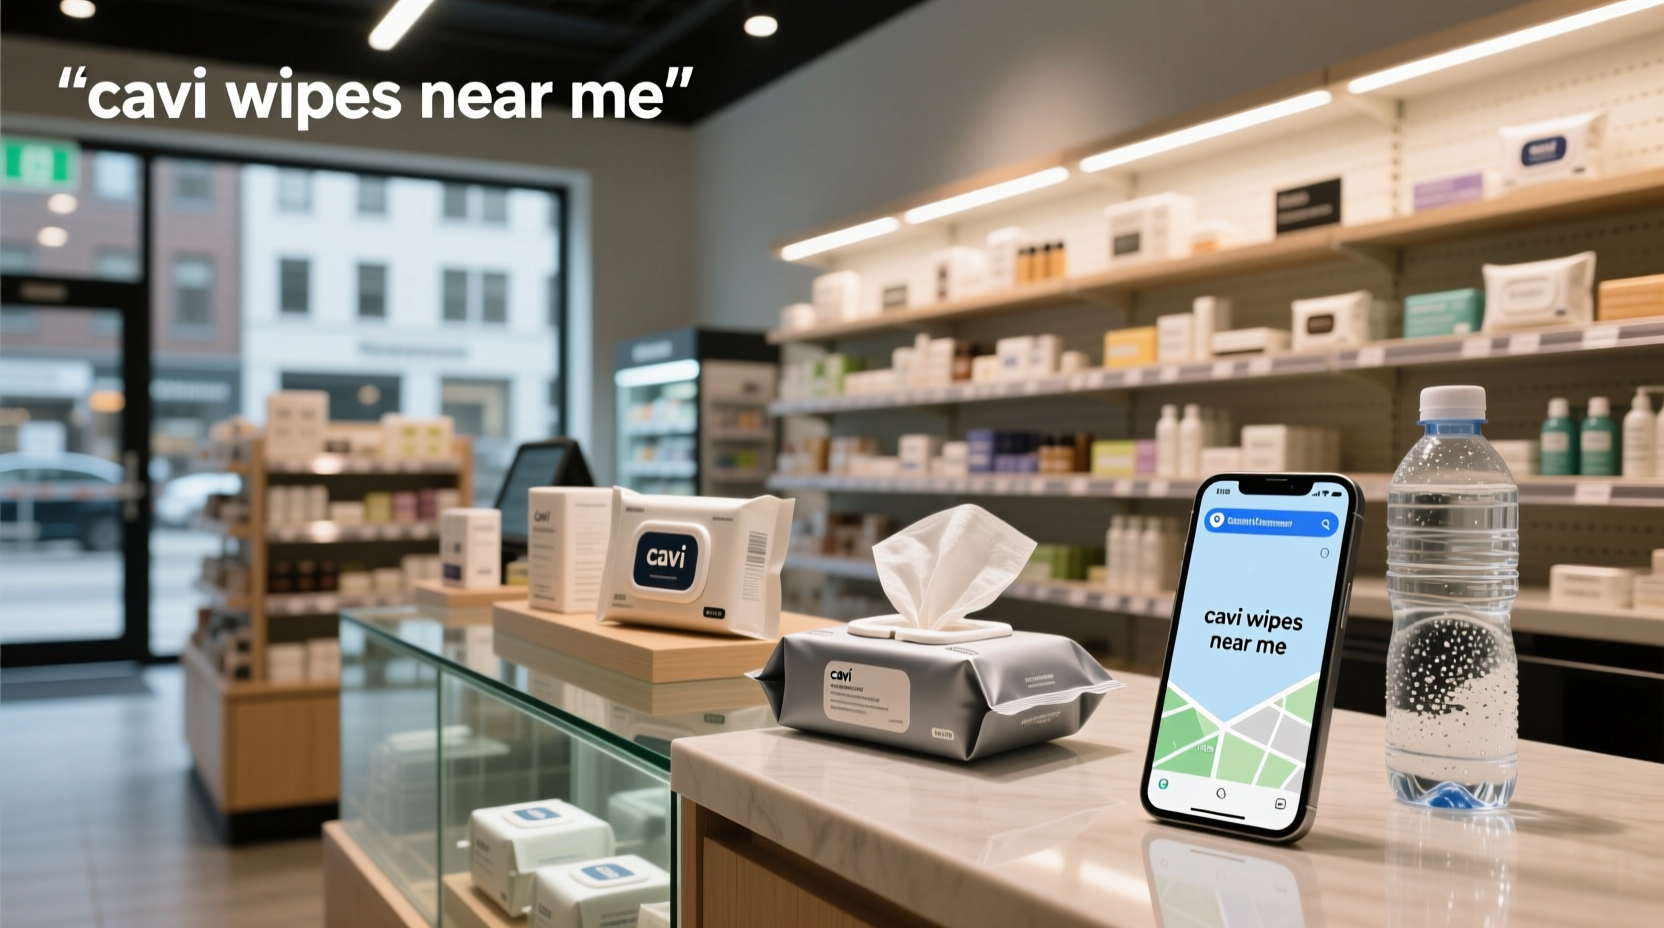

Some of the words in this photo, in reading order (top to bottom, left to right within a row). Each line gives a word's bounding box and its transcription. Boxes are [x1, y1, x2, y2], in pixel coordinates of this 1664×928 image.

[646, 544, 687, 569] cavi
[1204, 607, 1243, 626] cavi
[1246, 609, 1304, 632] wipes
[1209, 634, 1253, 652] near
[1255, 638, 1287, 655] me
[830, 668, 853, 682] cavi
